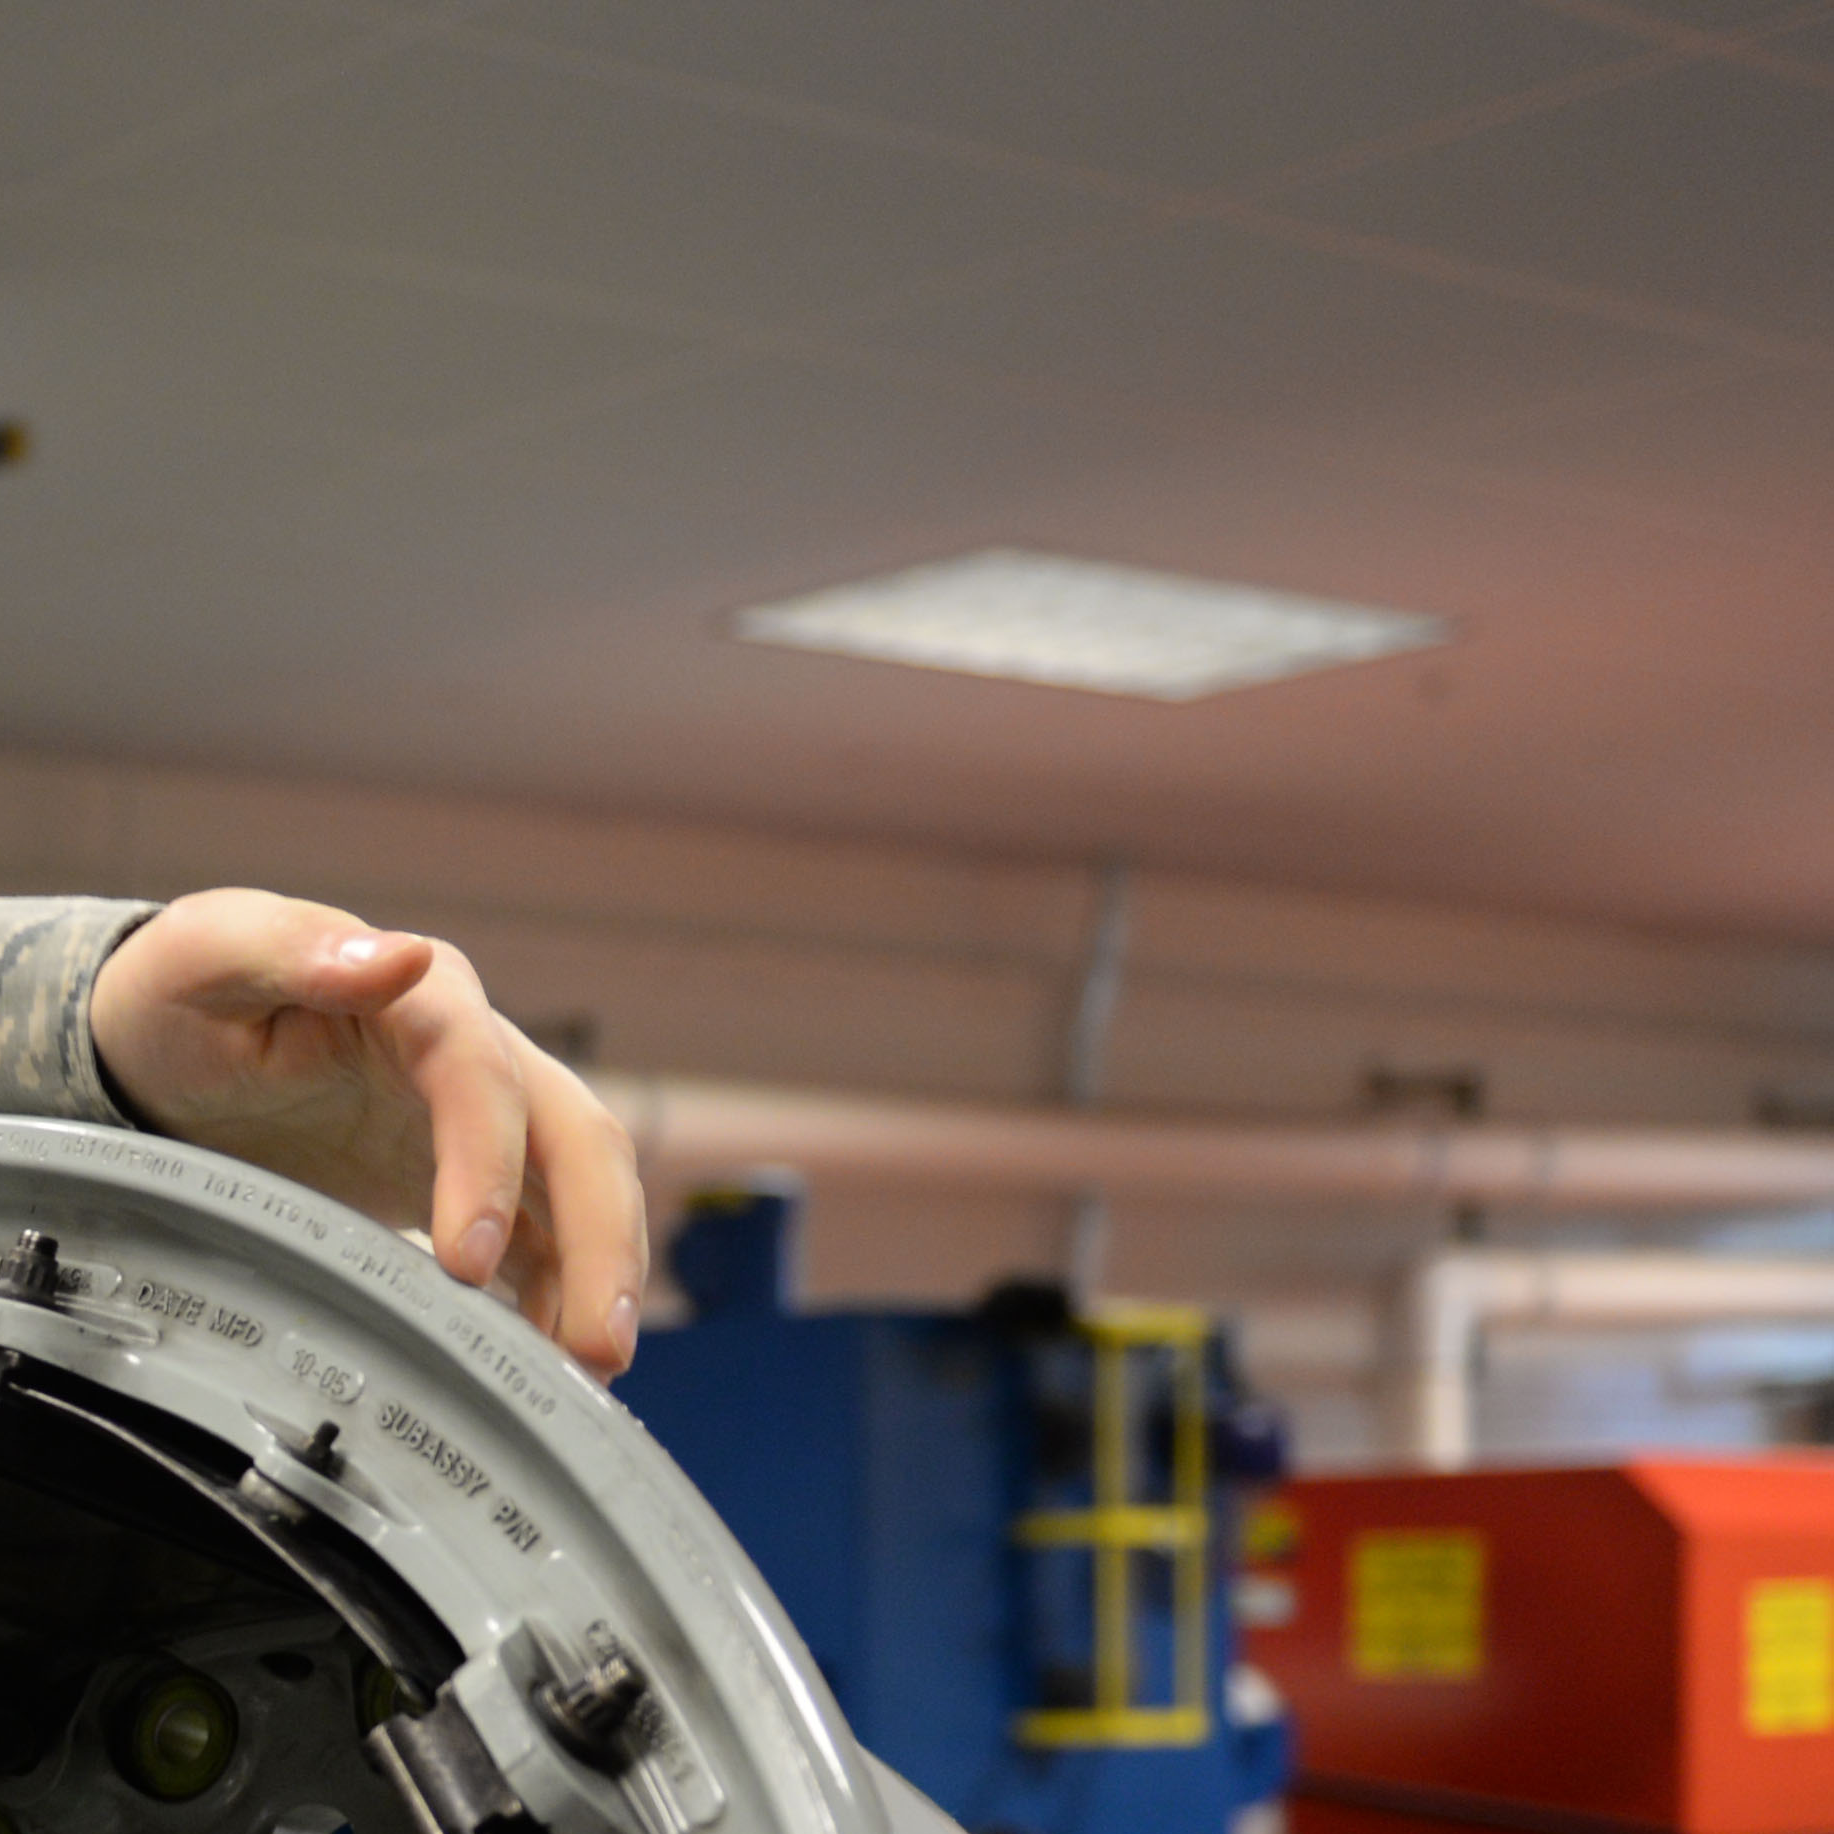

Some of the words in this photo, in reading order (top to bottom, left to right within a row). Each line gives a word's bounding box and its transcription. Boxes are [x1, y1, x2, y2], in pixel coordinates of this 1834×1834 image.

[135, 1280, 206, 1327] DATE
[208, 1308, 265, 1349] MFD
[290, 1347, 352, 1397] 10-05
[377, 1399, 491, 1499] SUBASSY
[491, 1498, 543, 1555] P/N
